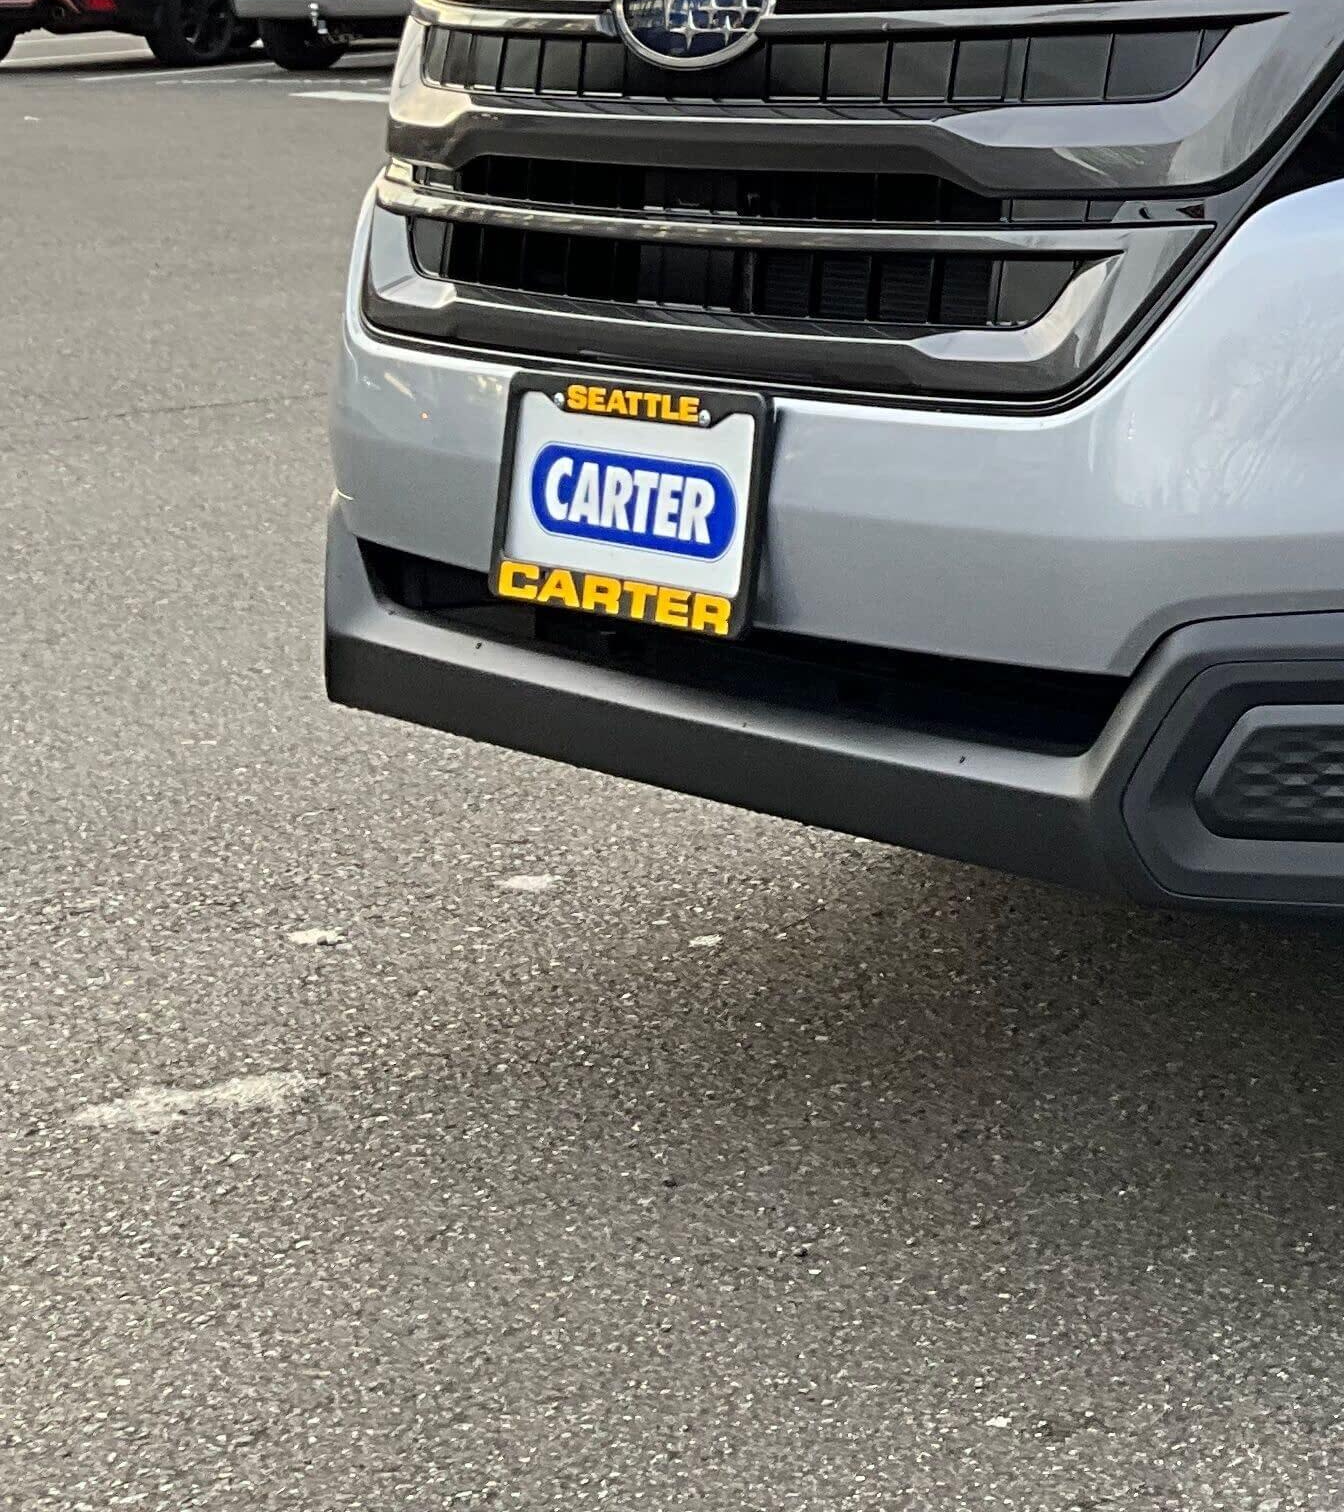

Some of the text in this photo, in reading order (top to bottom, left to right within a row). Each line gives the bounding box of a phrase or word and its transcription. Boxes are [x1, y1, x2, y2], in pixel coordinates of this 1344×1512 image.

[566, 384, 700, 423] SEATTLE
[545, 456, 715, 545] CARTER
[498, 560, 732, 636] CARTER
